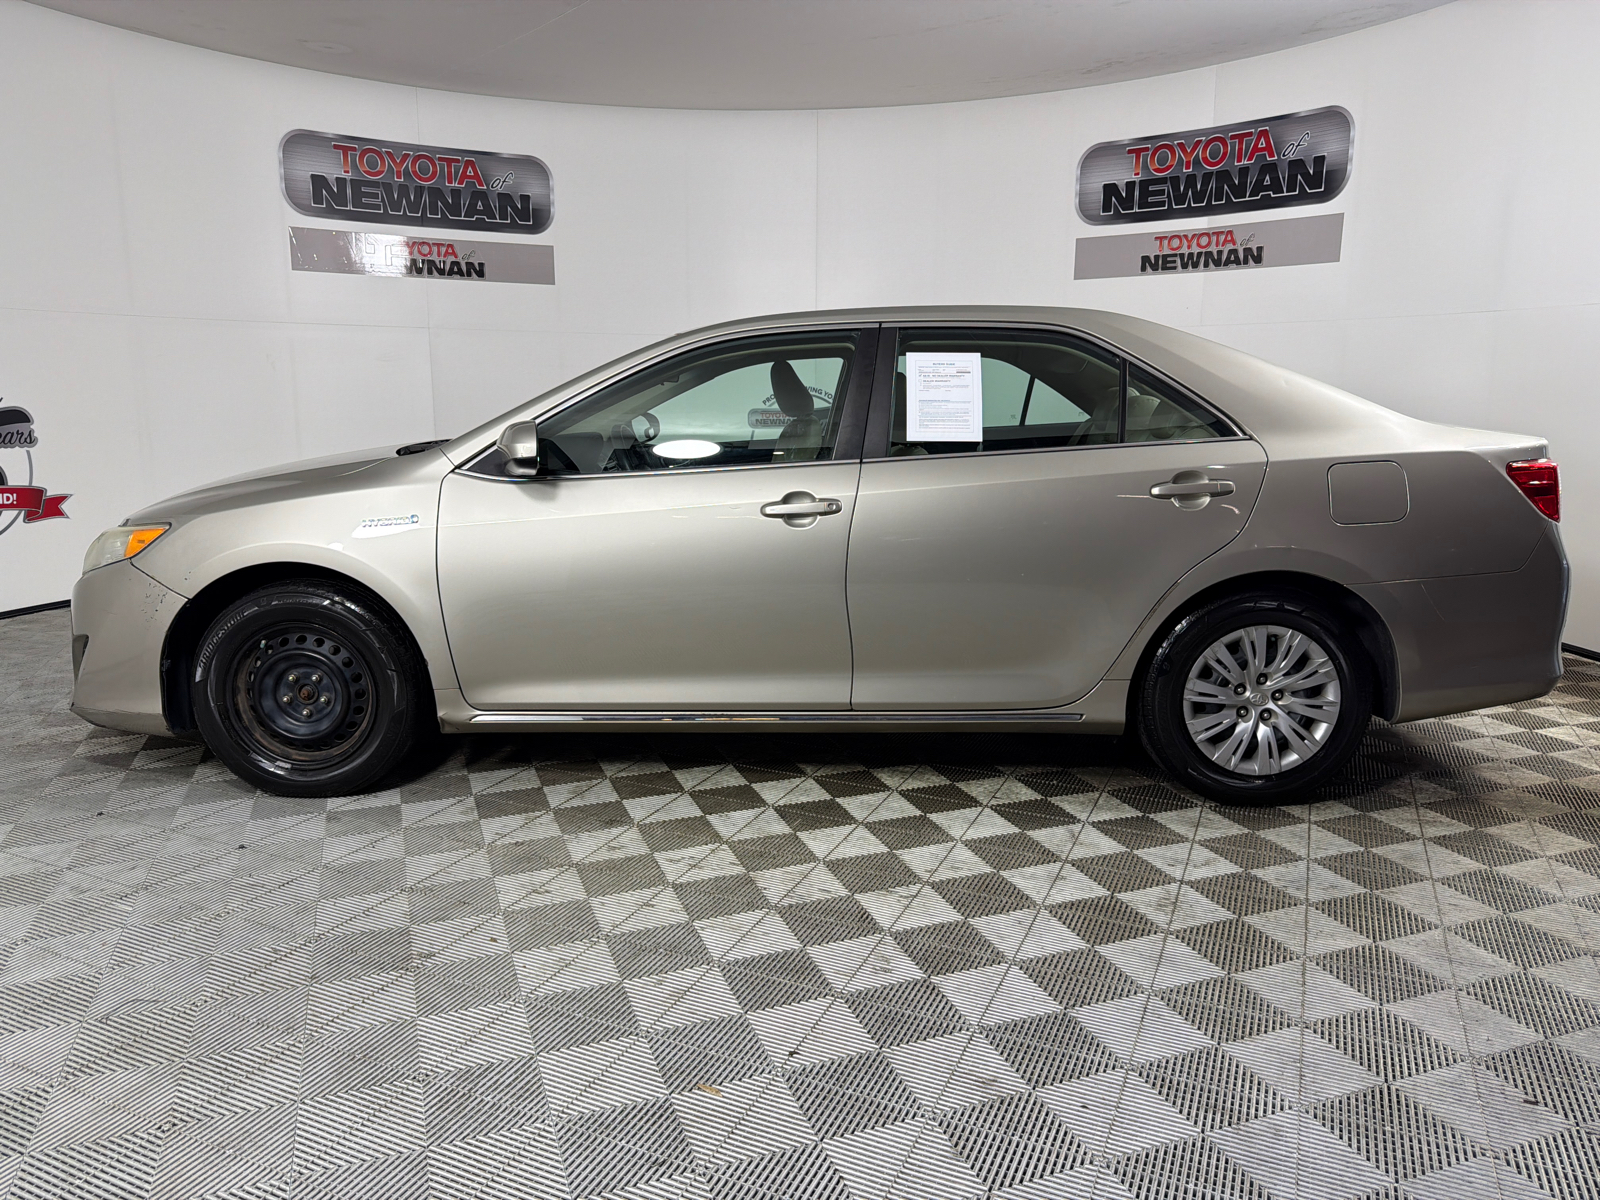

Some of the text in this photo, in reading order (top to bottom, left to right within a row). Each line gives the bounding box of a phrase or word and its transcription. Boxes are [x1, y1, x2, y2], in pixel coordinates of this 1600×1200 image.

[1127, 127, 1310, 177] TOYOTA of
[332, 142, 514, 190] TOYOTA of
[1100, 153, 1327, 215] NEWNAN
[310, 173, 532, 225] NEWNAN
[402, 240, 475, 261] YOTA of
[1154, 229, 1255, 253] TOYOTA of
[406, 259, 486, 279] WNAN
[1140, 245, 1264, 274] NEWNAN
[824, 391, 833, 400] YO
[0, 430, 35, 445] ars
[0, 493, 17, 504] D!
